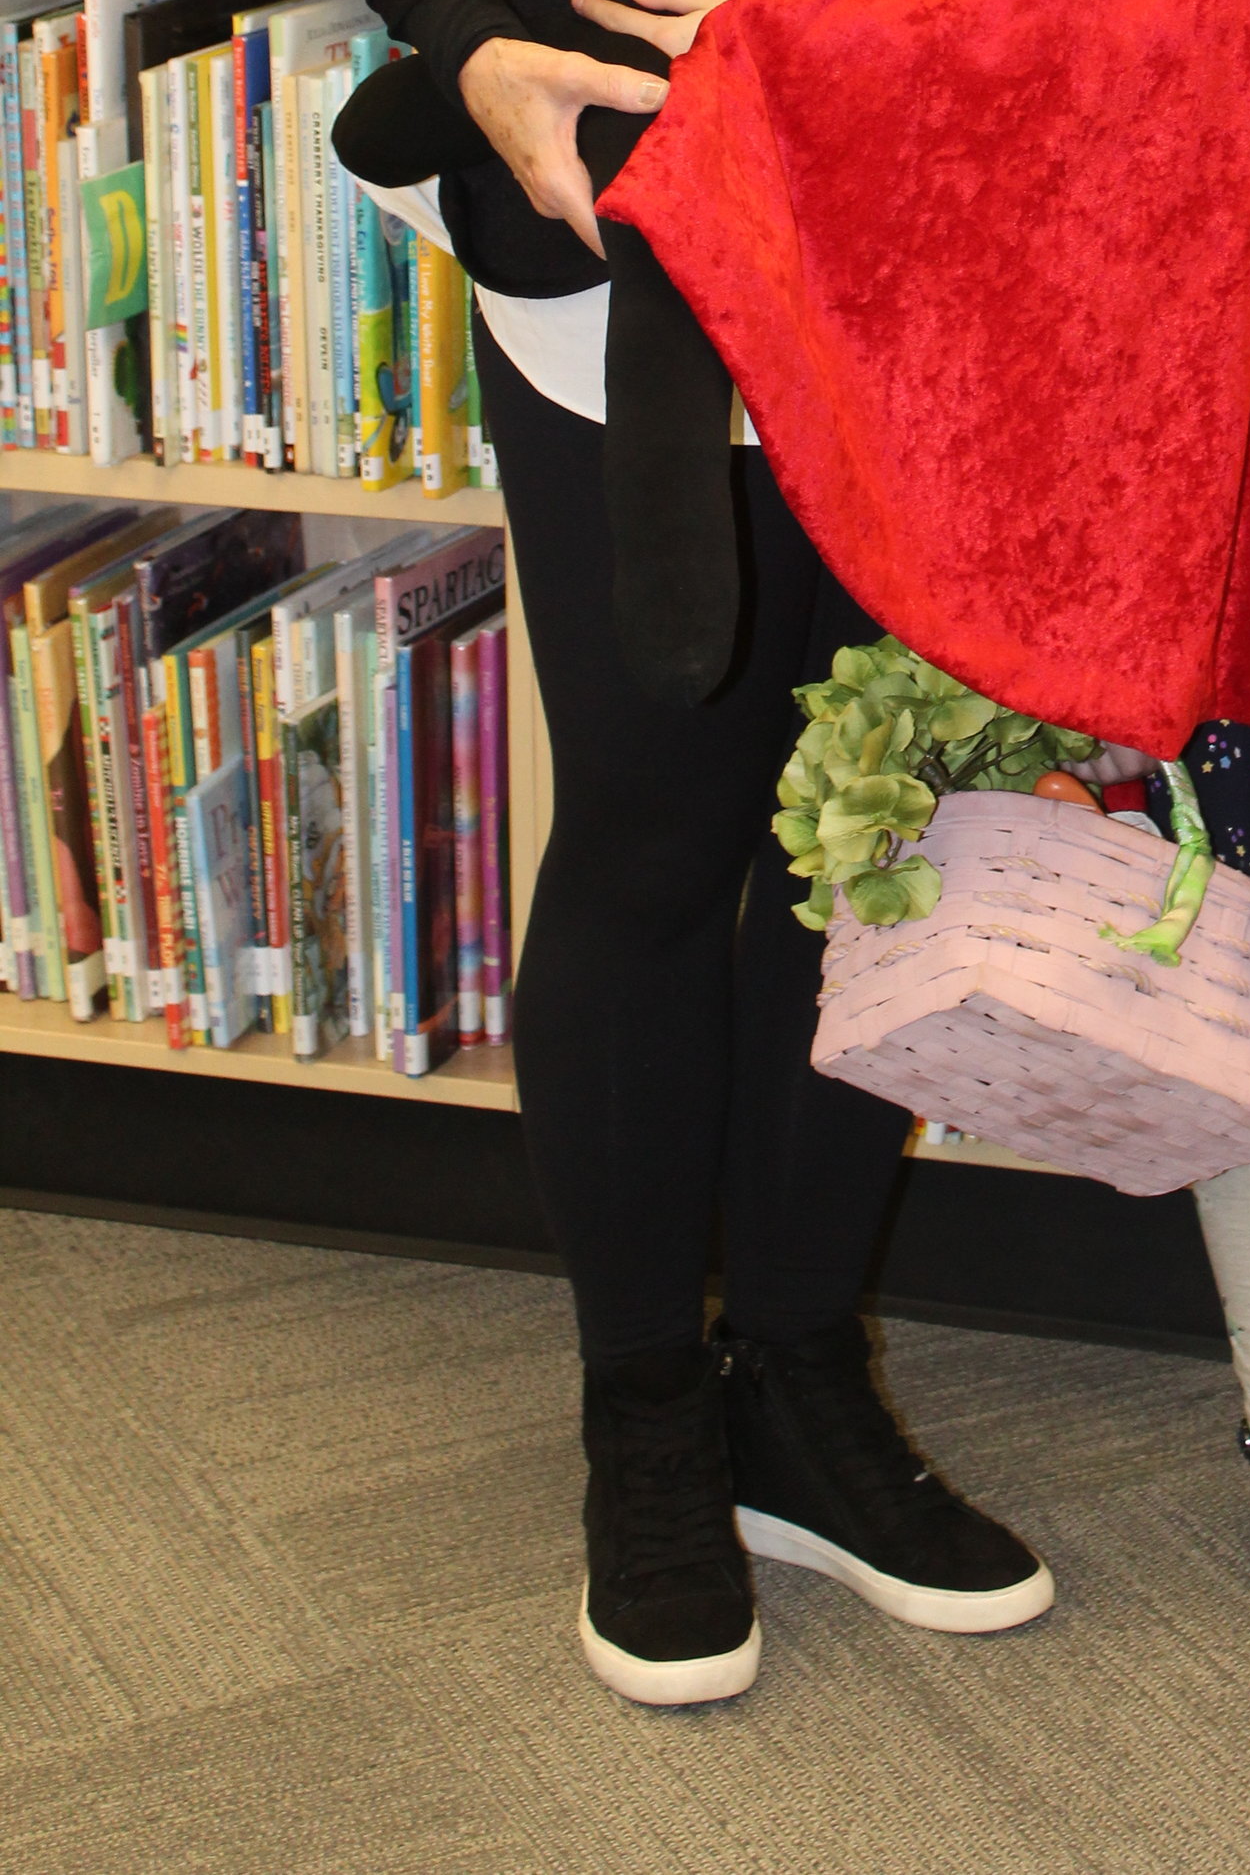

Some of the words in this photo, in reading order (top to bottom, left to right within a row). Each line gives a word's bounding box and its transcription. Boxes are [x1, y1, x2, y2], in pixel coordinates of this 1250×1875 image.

[312, 112, 321, 186] CRANBERRY
[99, 189, 143, 306] D
[193, 226, 203, 274] WOLFIE
[315, 194, 324, 282] THANKSGIVING
[195, 281, 204, 302] THE
[420, 271, 430, 295] Love
[196, 307, 206, 351] BUNNY
[419, 300, 431, 318] My
[319, 327, 328, 370] DEVLIN
[422, 323, 432, 354] White
[423, 359, 434, 387] Shoes
[396, 543, 506, 636] SPARTAC
[131, 756, 144, 809] Zombie
[174, 816, 191, 886] HORRIBLE
[181, 890, 196, 930] BEAR!
